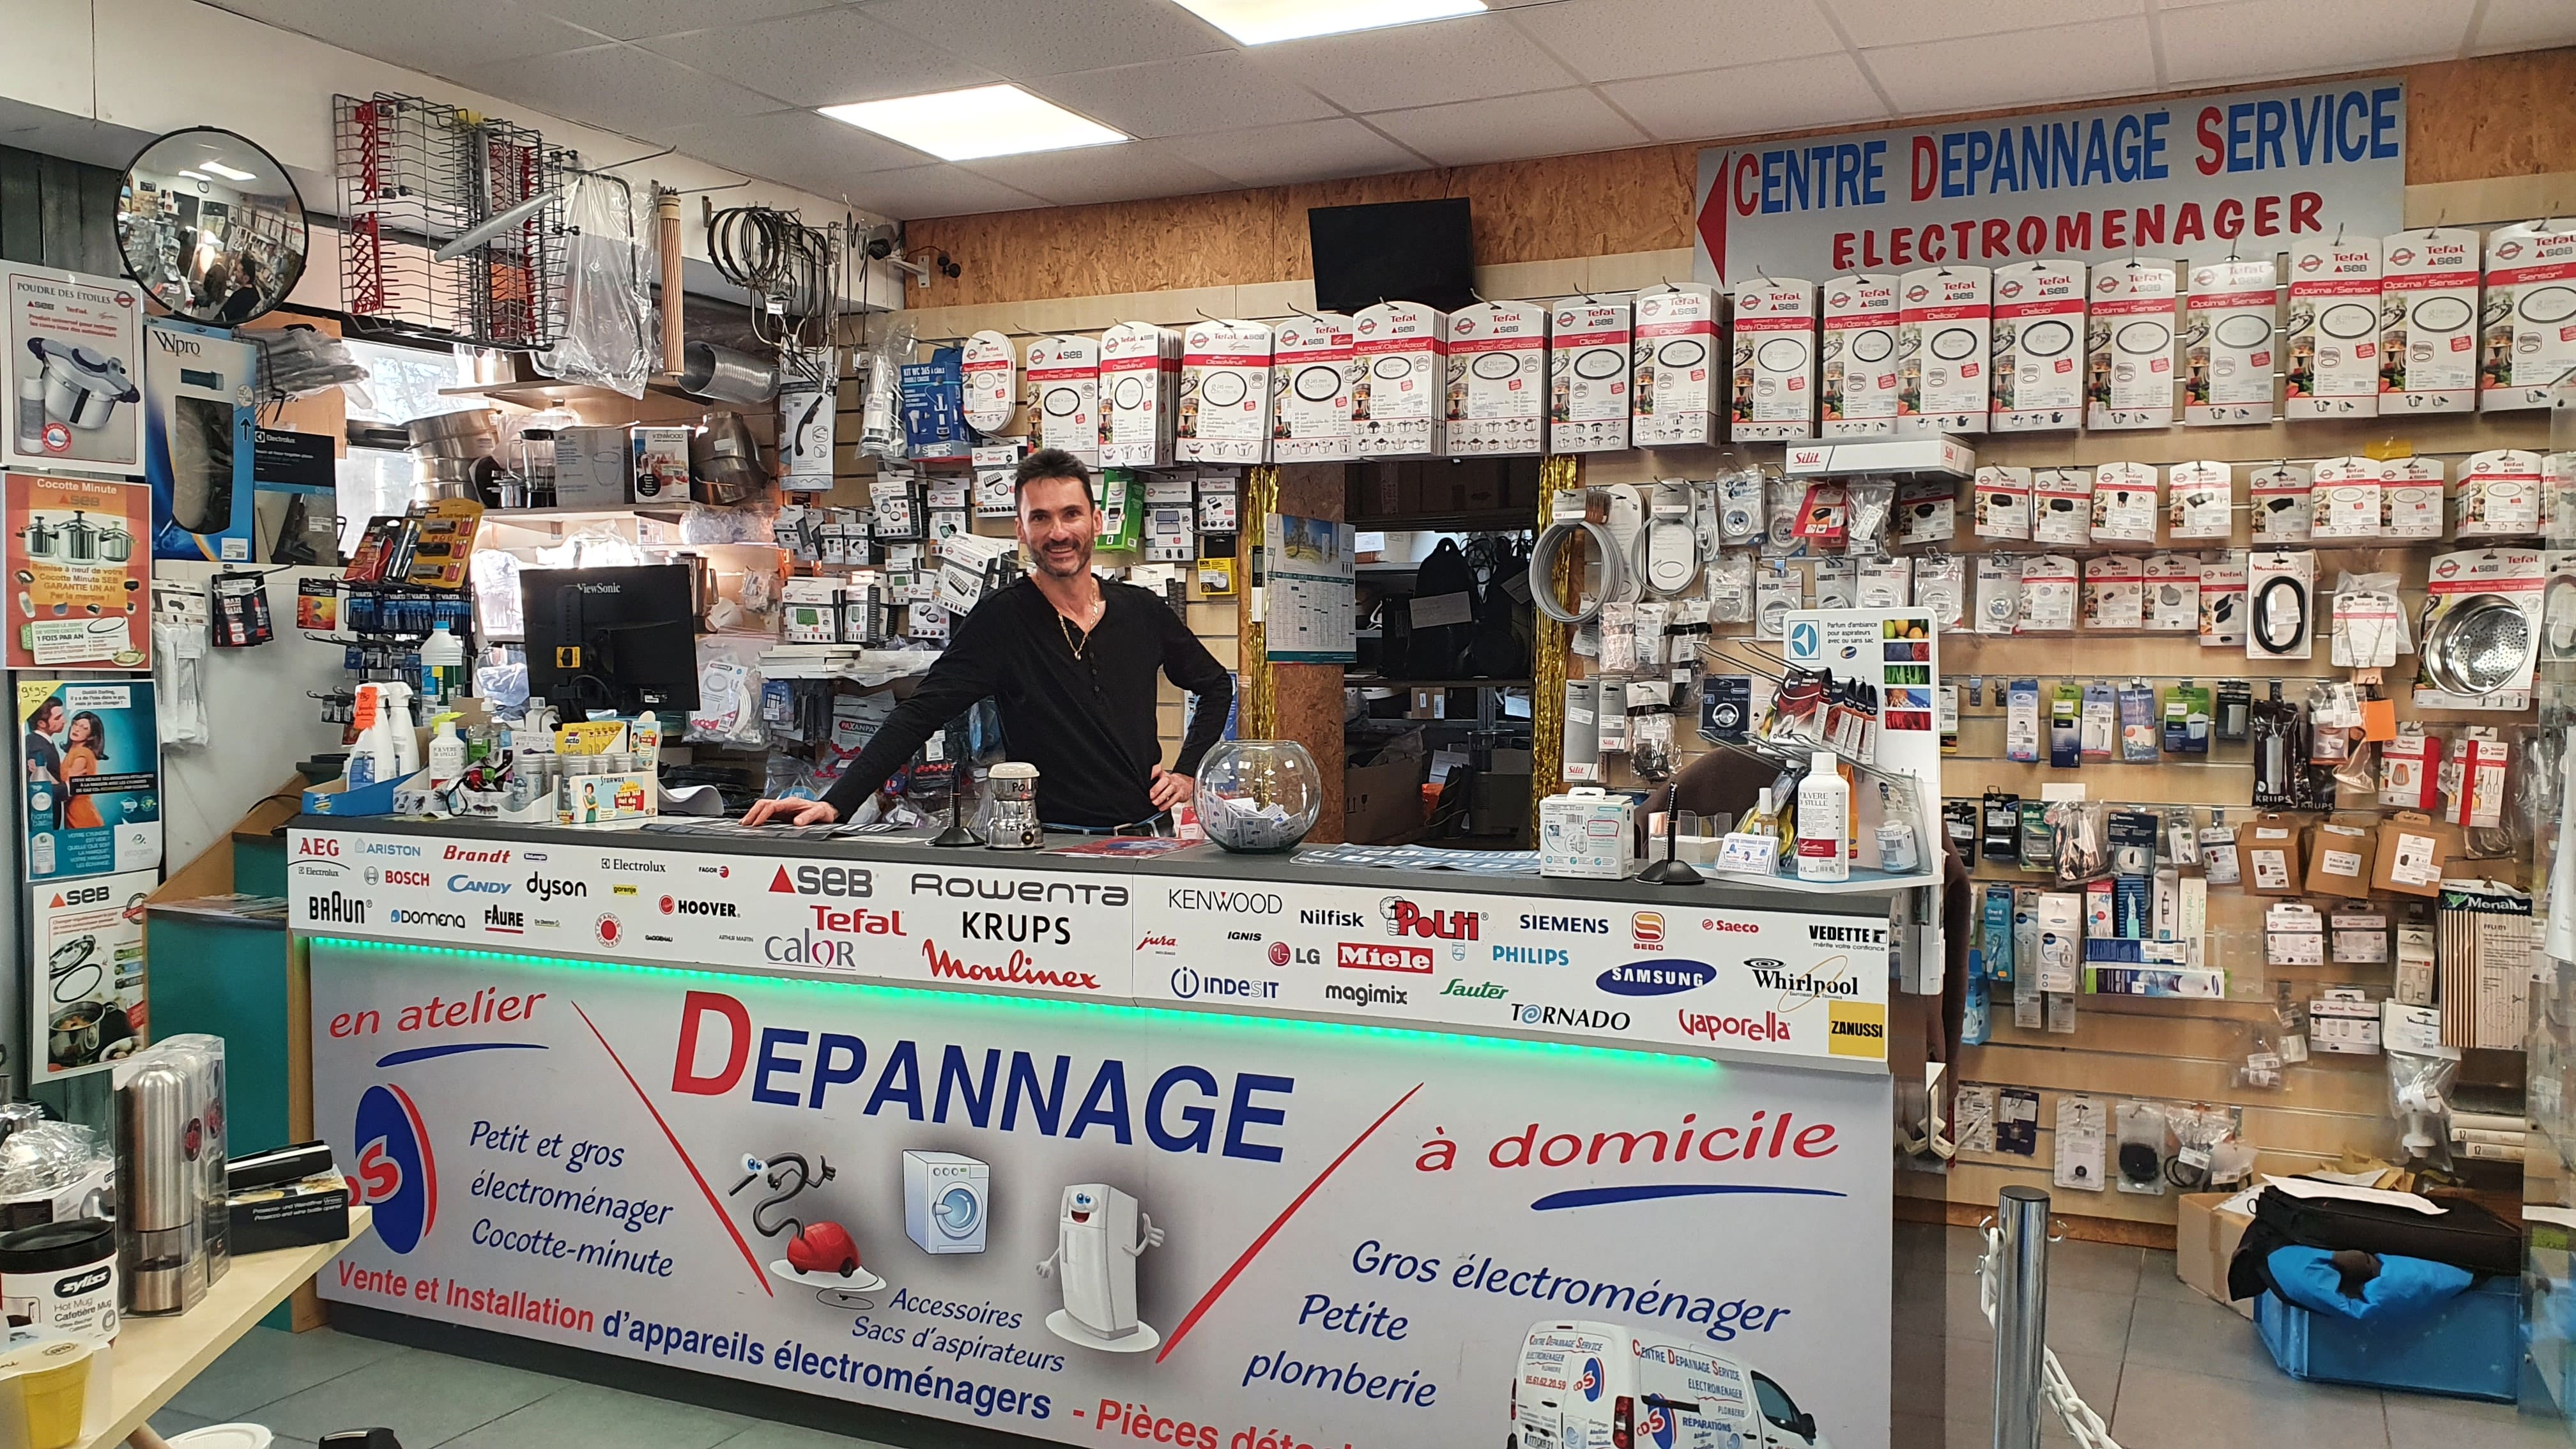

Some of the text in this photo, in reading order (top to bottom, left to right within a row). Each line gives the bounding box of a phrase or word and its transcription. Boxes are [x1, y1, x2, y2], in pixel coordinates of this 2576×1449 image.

[1733, 87, 2401, 217] CENTRE DEPANNAGE SERVICE
[1832, 192, 2324, 270] ELECTROMENAGER
[17, 282, 56, 296] POUDRE
[58, 289, 74, 298] DES
[152, 330, 200, 357] Wpro
[1796, 452, 1820, 464] Silit
[37, 479, 117, 494] Cocotte Minute
[32, 564, 63, 572] Remise
[2507, 555, 2539, 564] Tefal
[39, 573, 72, 582] Cocotte
[73, 574, 99, 583] Minute
[44, 582, 88, 592] GARANTIE
[577, 582, 620, 594] ViewSonic
[2256, 795, 2291, 803] KRUPS
[2301, 801, 2333, 811] KRUPS
[299, 838, 339, 856] AEG
[367, 843, 420, 856] ARISTON
[443, 845, 510, 863] Brandt
[307, 867, 339, 877] Electrolux
[614, 859, 666, 873] Electrolux
[385, 871, 429, 886] BOSCH
[447, 874, 512, 894] CANDY
[526, 871, 586, 901] dyson
[797, 865, 873, 897] SEB
[66, 887, 109, 905] SEB
[613, 885, 636, 894] gorenje
[310, 891, 364, 924] BRAUN
[678, 900, 737, 917] HOOVER
[1169, 889, 1282, 915] KENWOOD
[2468, 896, 2528, 910] Menal
[485, 904, 524, 927] FAURE
[809, 905, 907, 937] Tefal
[1300, 910, 1364, 927] Nilfisk
[1520, 914, 1609, 934] SIEMENS
[1716, 919, 1759, 933] Saeco
[962, 912, 1070, 944] KRUPS
[1227, 931, 1262, 941] IGNIS
[1809, 925, 1869, 943] VEDETTE
[1136, 930, 1176, 951] jura
[922, 939, 1101, 989] Moulinex
[1296, 948, 1320, 965] LG
[1340, 946, 1431, 970] Miele
[1492, 945, 1569, 965] PHILIPS
[1612, 967, 1703, 986] SAMSUNG
[1752, 969, 1859, 998] Whirlpool
[1326, 984, 1407, 1007] magimix
[1439, 978, 1509, 999] Sauter
[330, 986, 547, 1038] en atelier
[1511, 1003, 1630, 1031] TORNADO
[1831, 1020, 1883, 1038] ZANUSSI
[671, 990, 1295, 1163] DEPANNAGE
[470, 1121, 624, 1172] Petit et gros
[1415, 1110, 1839, 1172] à domicile
[471, 1169, 673, 1232] électroménager
[471, 1218, 673, 1278] Cocotte-minute
[61, 1271, 108, 1293] zyliss
[1353, 1240, 1790, 1341] Gros électroménager
[54, 1298, 93, 1312] Hot Mug
[54, 1300, 112, 1322] Cafetière Mug
[889, 1287, 1022, 1331] Accessoires
[1300, 1294, 1408, 1340] Petite
[338, 1260, 408, 1297] Vente
[415, 1277, 440, 1304] et
[447, 1278, 594, 1333] Installation
[602, 1309, 765, 1366] d'appareils
[774, 1337, 1052, 1422] électroménagers
[1096, 1399, 1219, 1449] Pièces
[852, 1315, 1066, 1375] Sacs d'aspirateurs
[1576, 1337, 1603, 1352] SERVICE
[1632, 1339, 1740, 1381] CENTRE DEPANNAGE SERVICE
[1242, 1351, 1437, 1407] plomberie
[1688, 1378, 1743, 1399] ELECTROMENAGER
[1636, 1411, 1664, 1437] CDS
[1682, 1415, 1732, 1432] RÉPARATIONS
